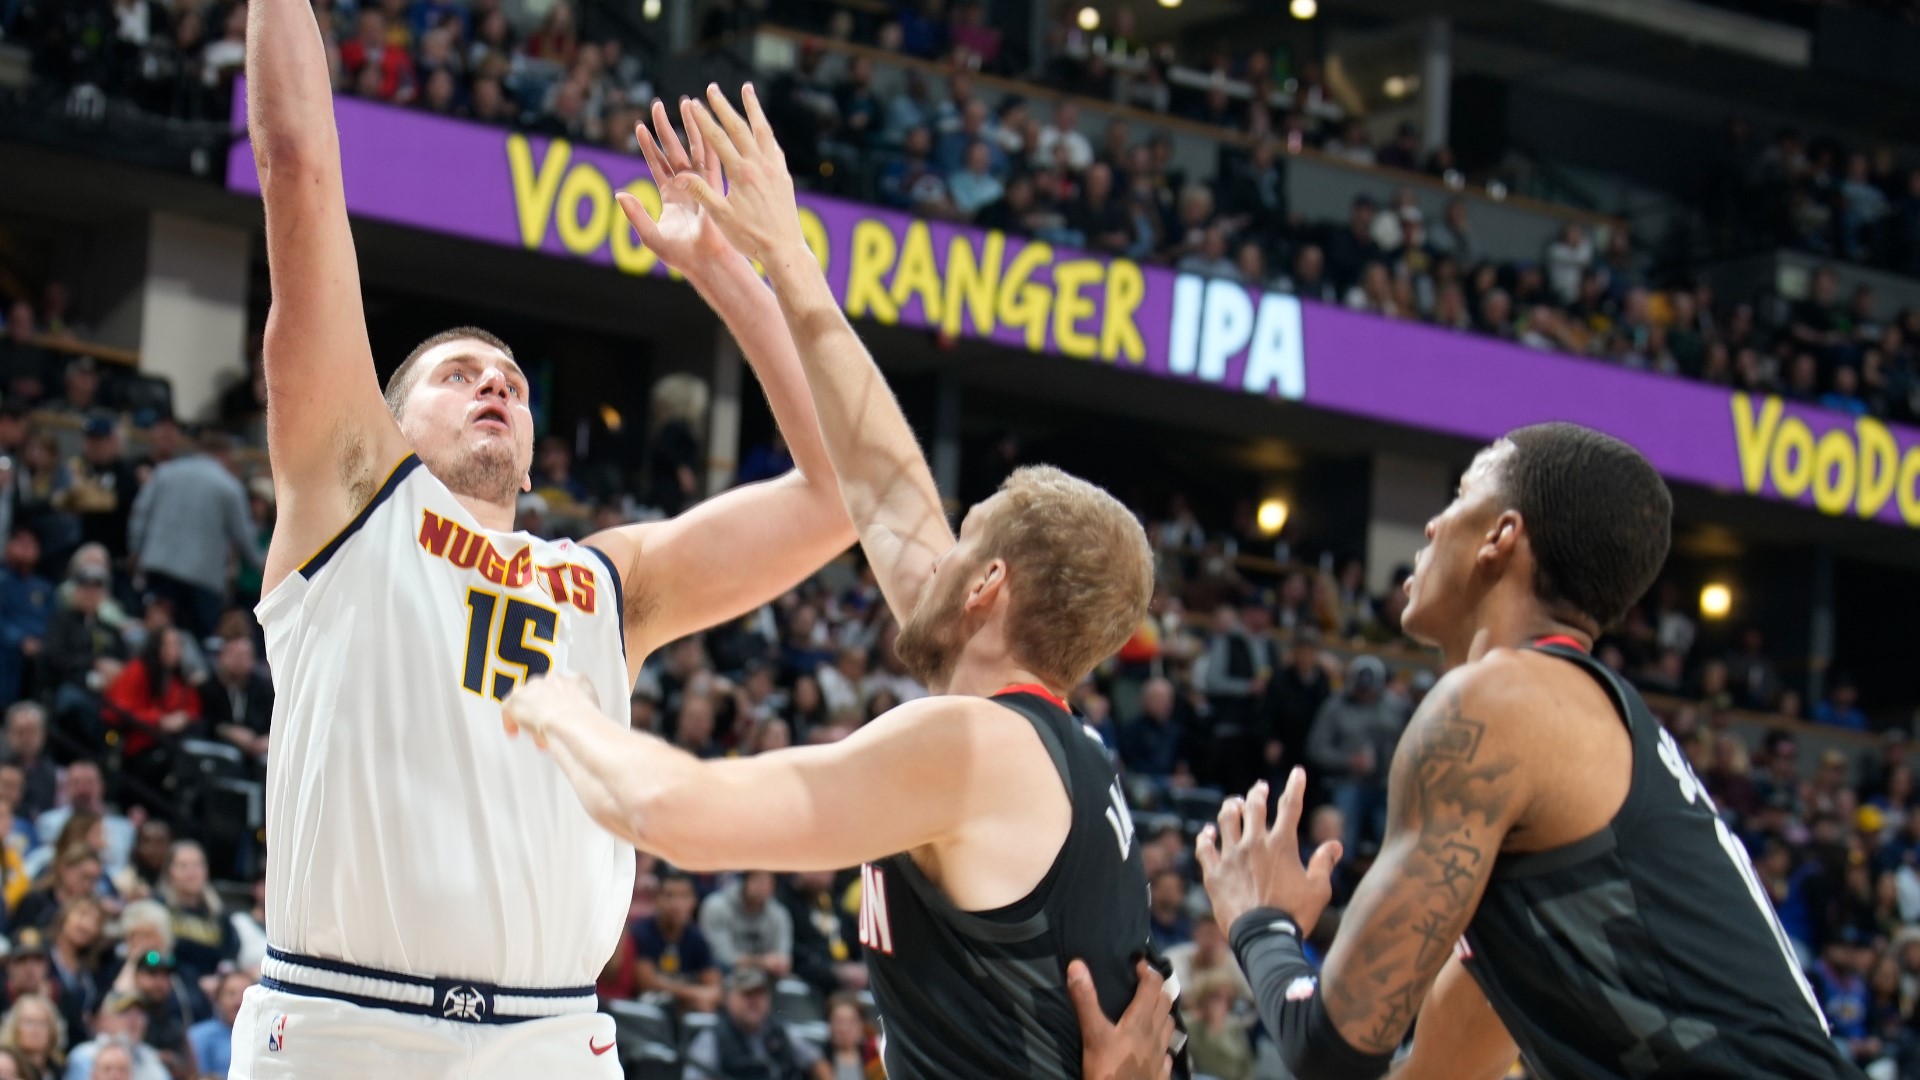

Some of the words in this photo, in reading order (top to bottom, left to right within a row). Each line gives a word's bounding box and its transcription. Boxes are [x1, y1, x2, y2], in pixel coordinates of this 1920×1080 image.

[846, 219, 1145, 364] RANGER
[1169, 272, 1305, 400] IPA
[418, 507, 598, 615] NUGGTS
[461, 585, 560, 705] 15
